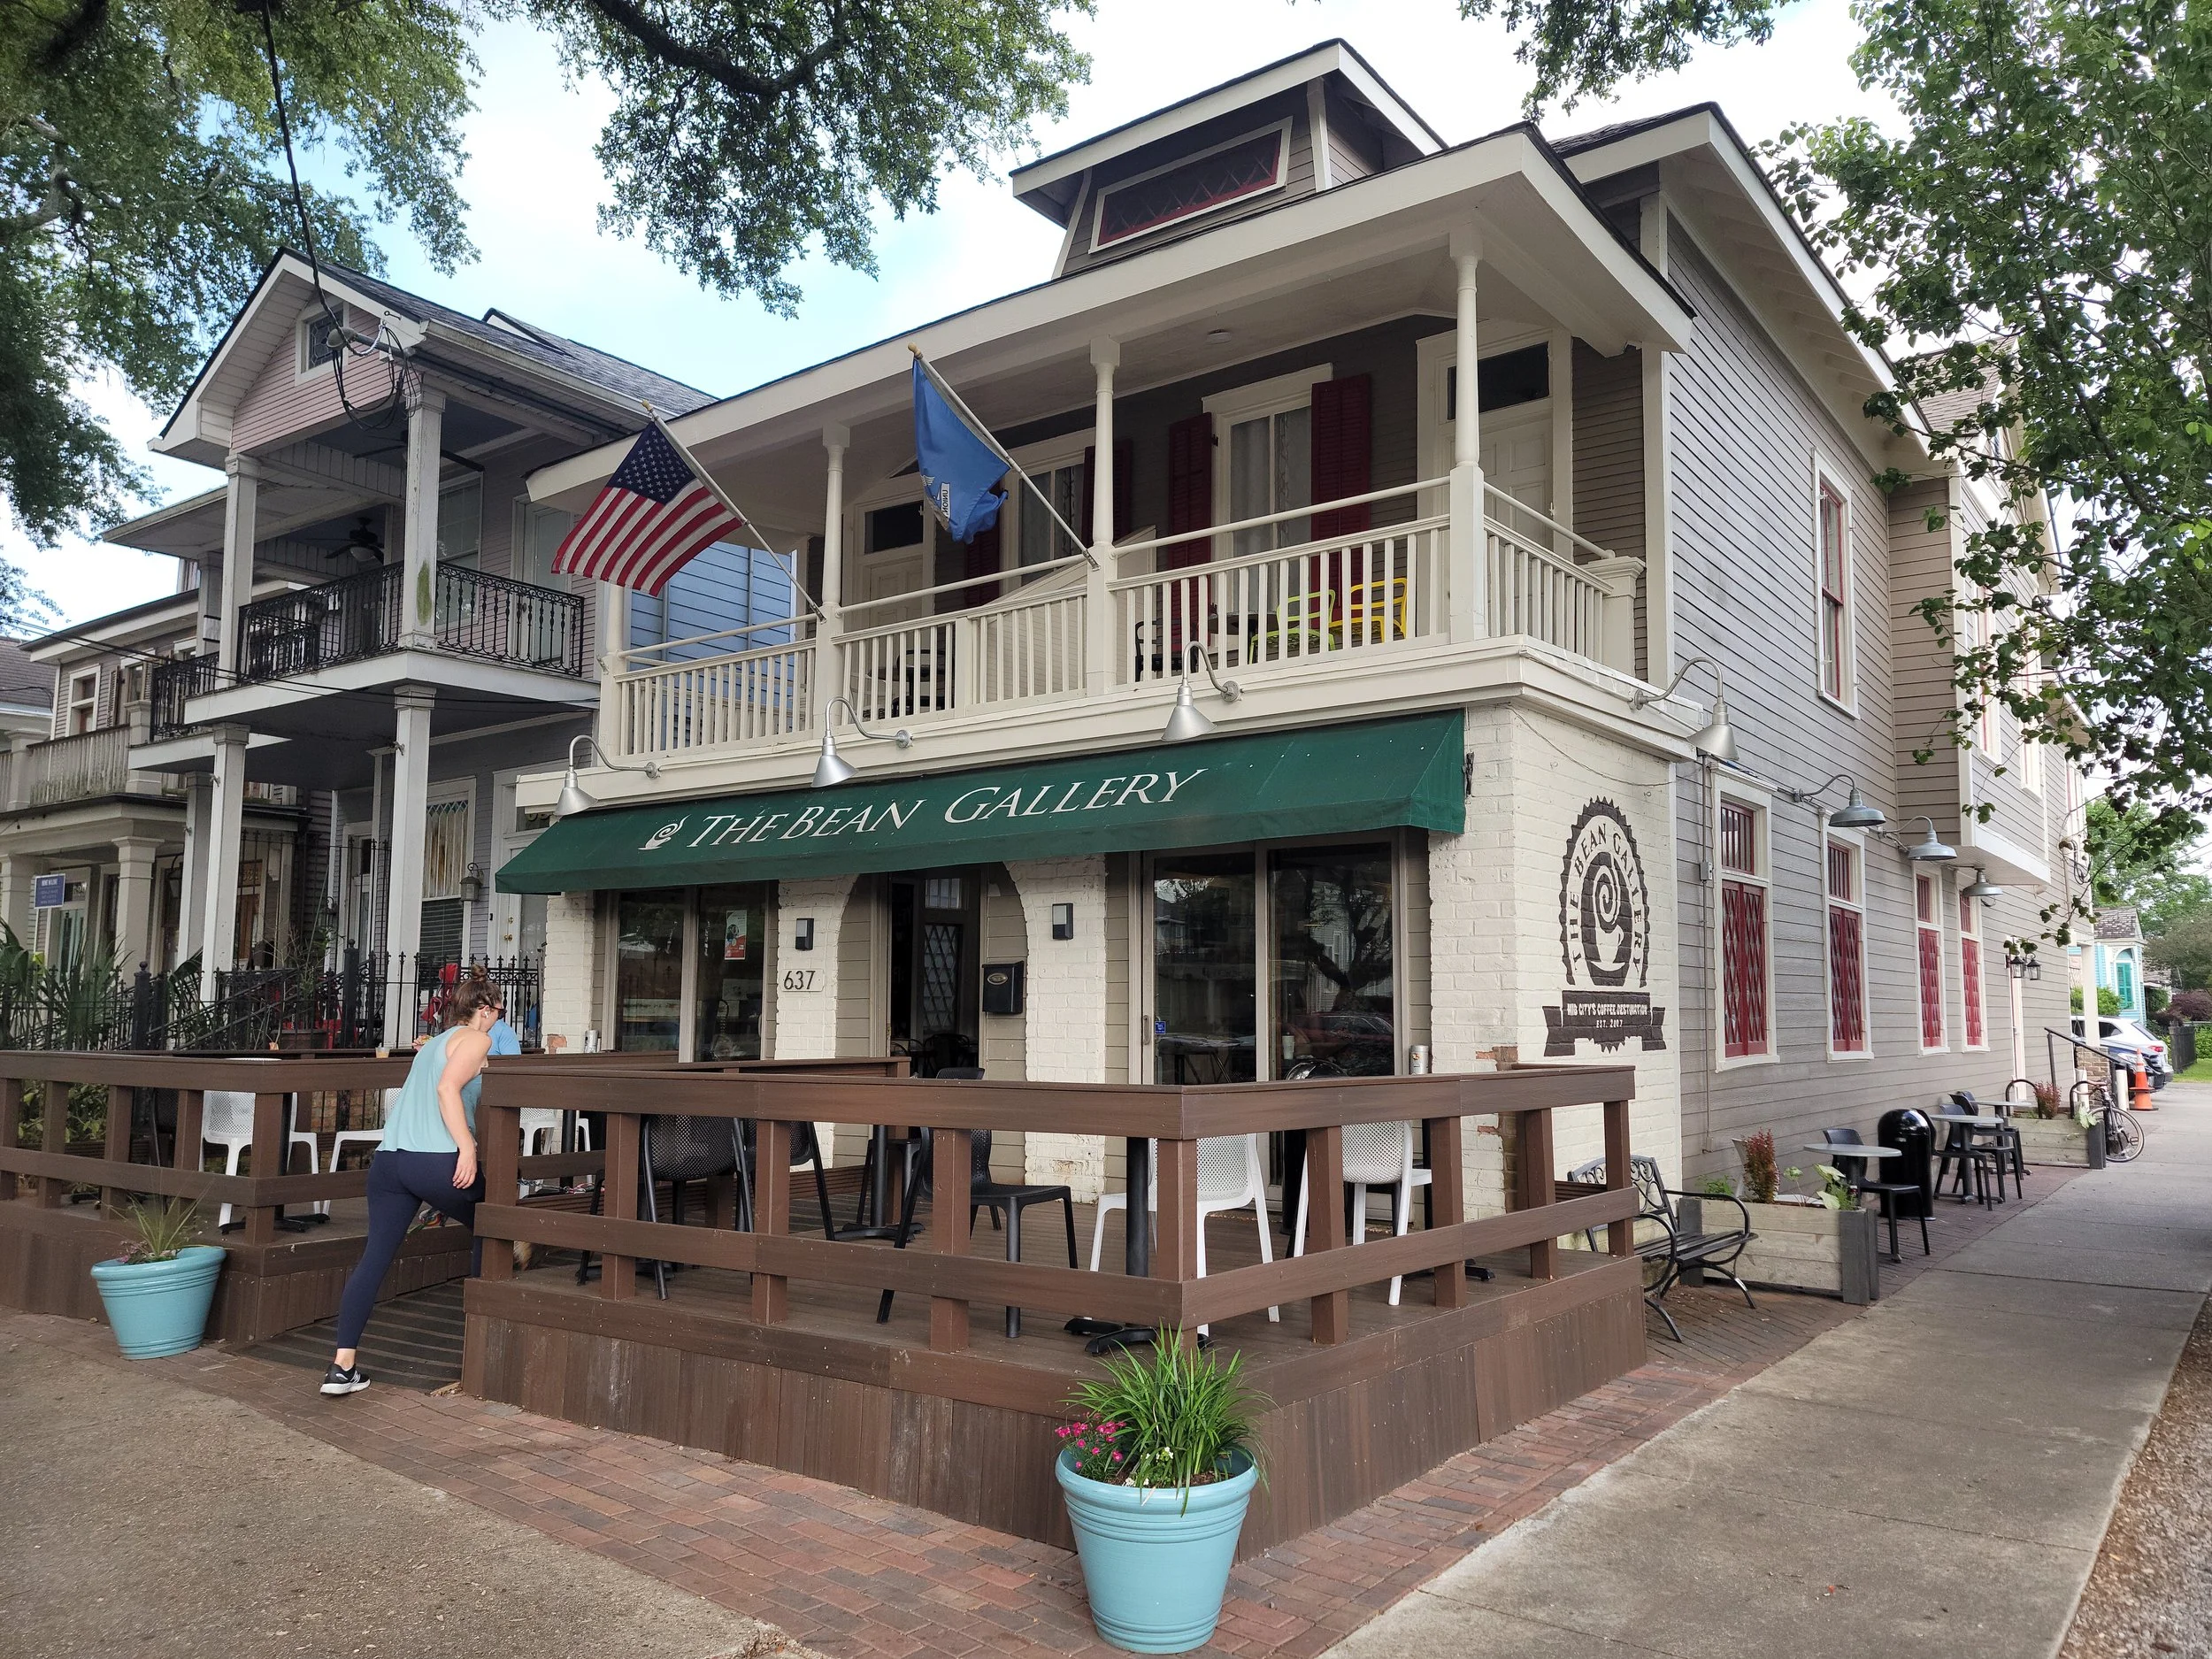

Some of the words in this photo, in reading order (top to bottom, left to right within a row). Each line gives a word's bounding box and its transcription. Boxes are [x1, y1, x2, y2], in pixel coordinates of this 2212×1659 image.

[687, 813, 789, 848] THE
[778, 799, 927, 841] BEAN
[944, 768, 1209, 824] GALLERY
[1574, 823, 1607, 878] BEAN
[1613, 833, 1642, 973] GALLERY
[1570, 891, 1582, 972] THE
[783, 970, 817, 990] 637
[1578, 1002, 1597, 1016] CITY'S
[1597, 1002, 1617, 1016] COFFEE
[1596, 1019, 1609, 1028] EST.
